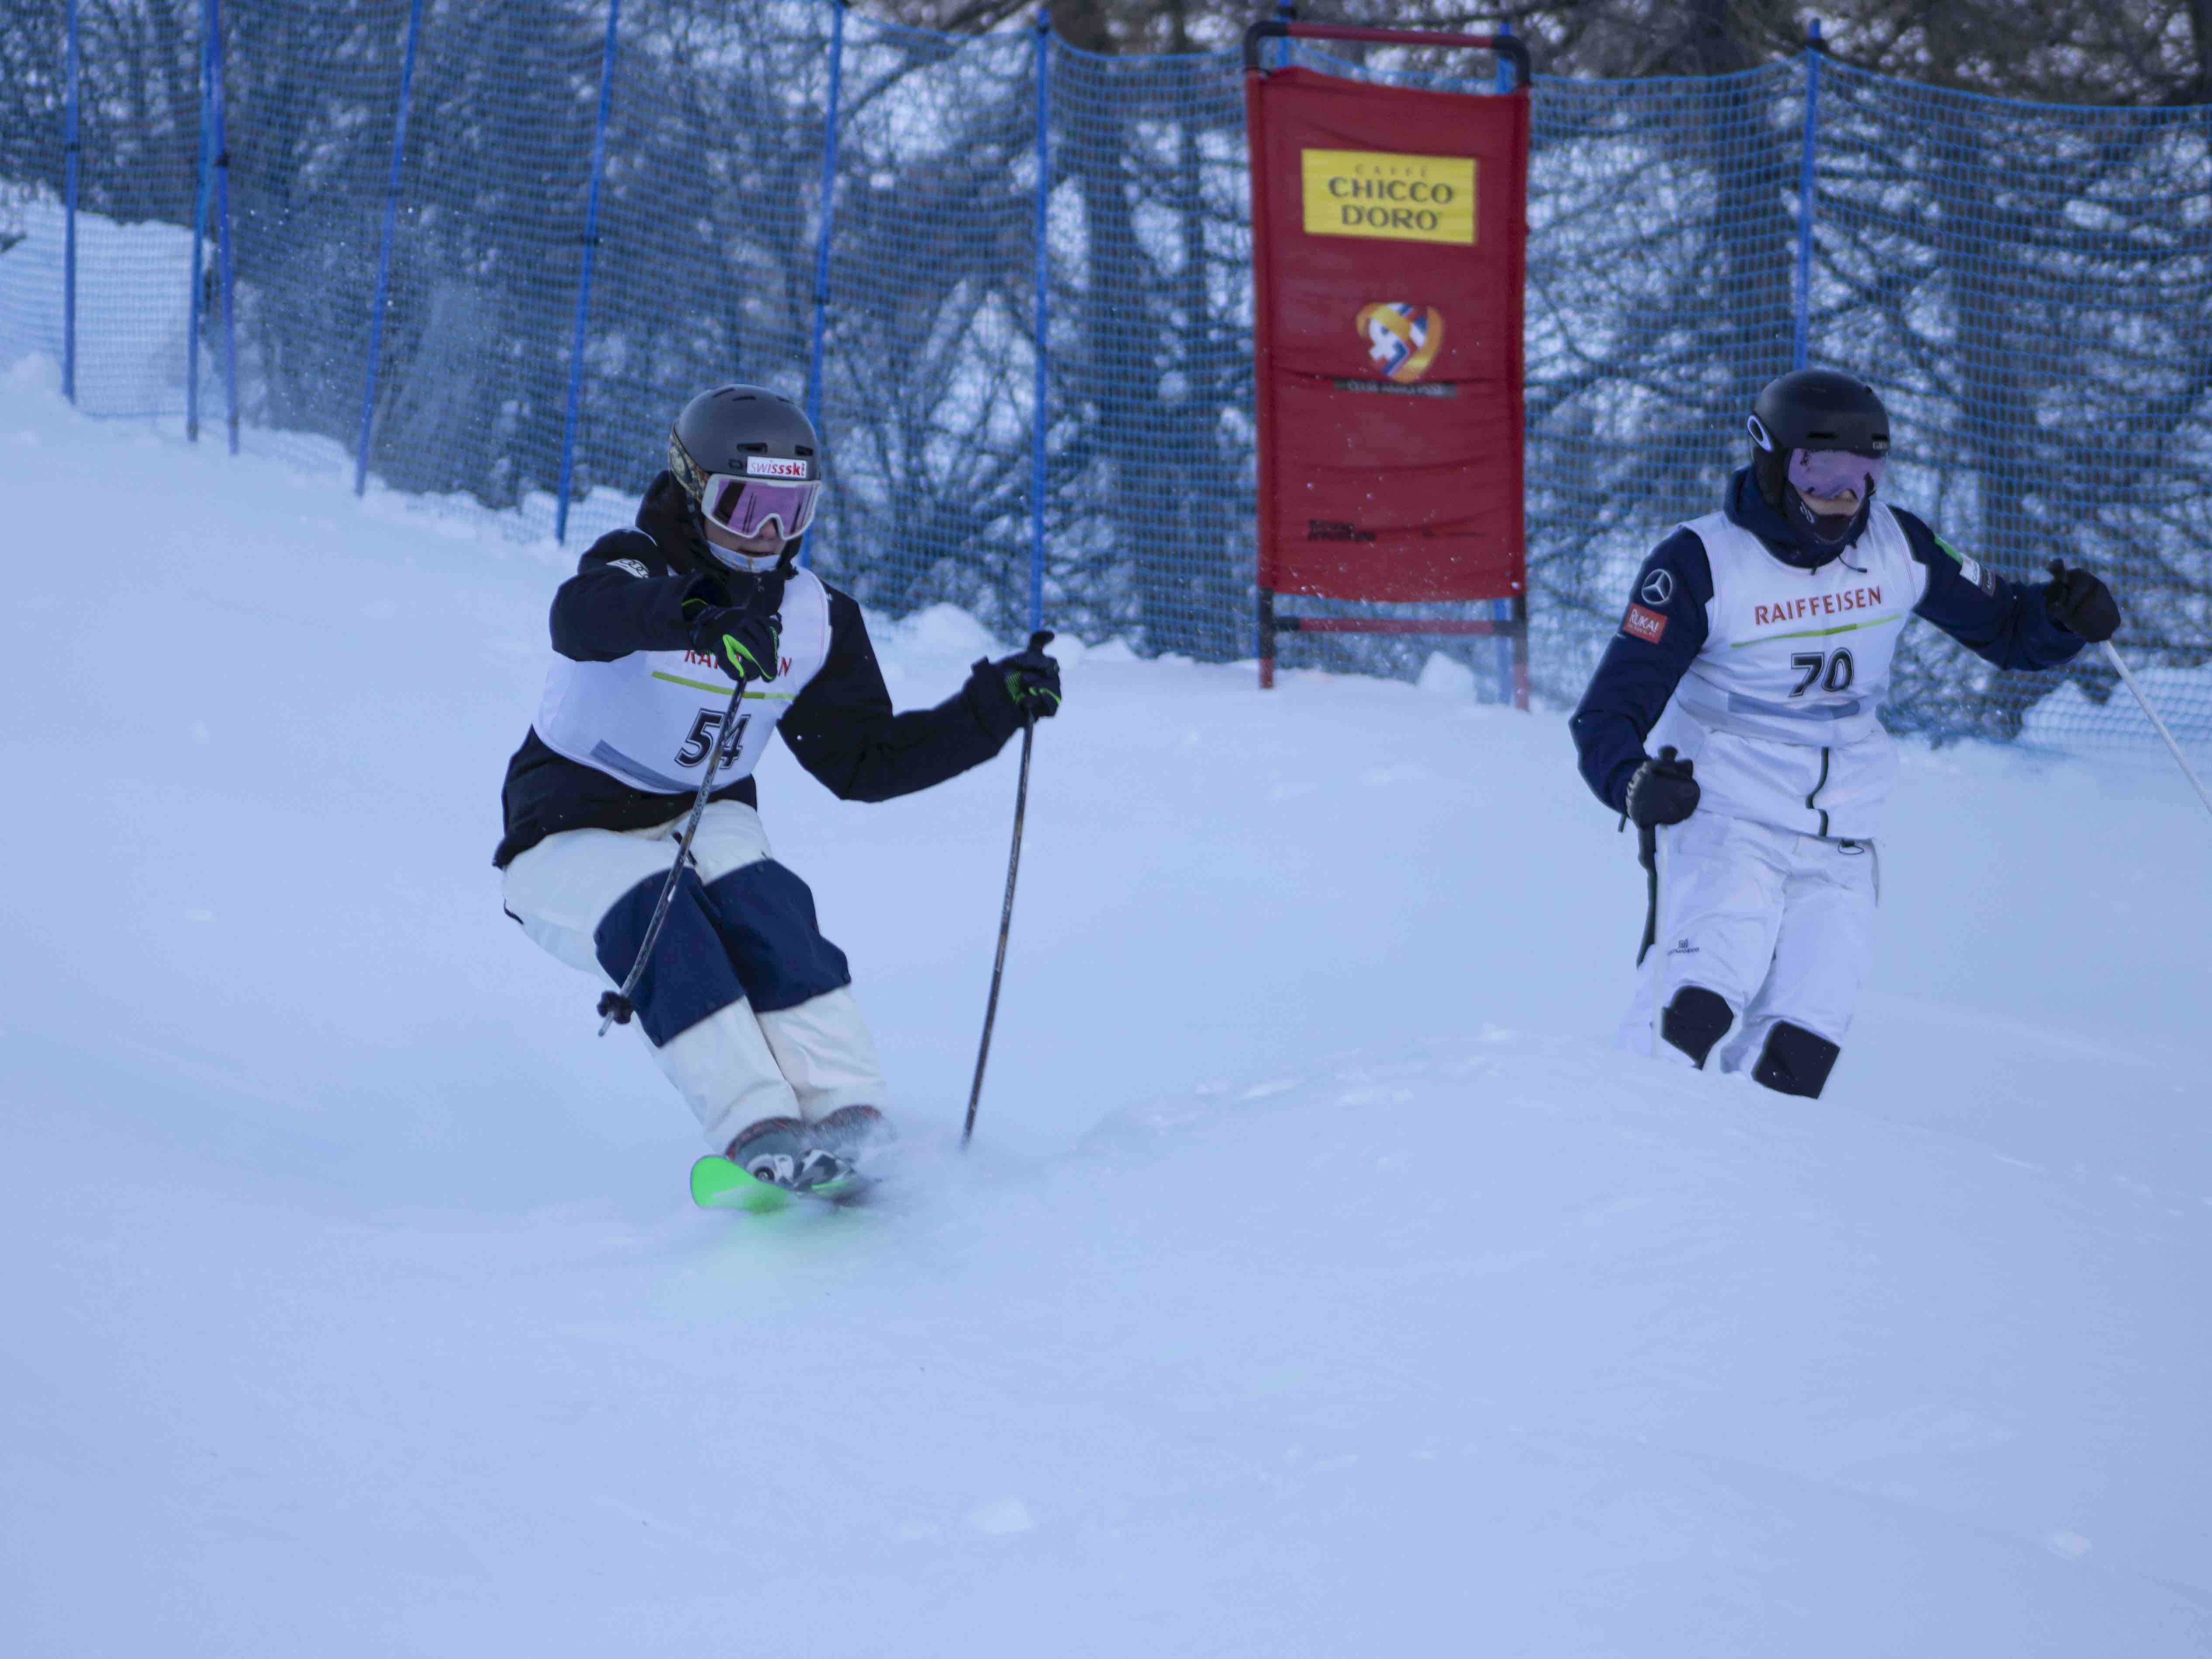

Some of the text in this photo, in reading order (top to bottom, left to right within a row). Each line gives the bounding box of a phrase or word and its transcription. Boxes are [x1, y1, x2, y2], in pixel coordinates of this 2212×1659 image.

[1329, 177, 1453, 204] CHICCO
[1754, 586, 1881, 625] RAIFFEISEN
[1788, 647, 1854, 697] 70
[674, 707, 751, 769] 54
